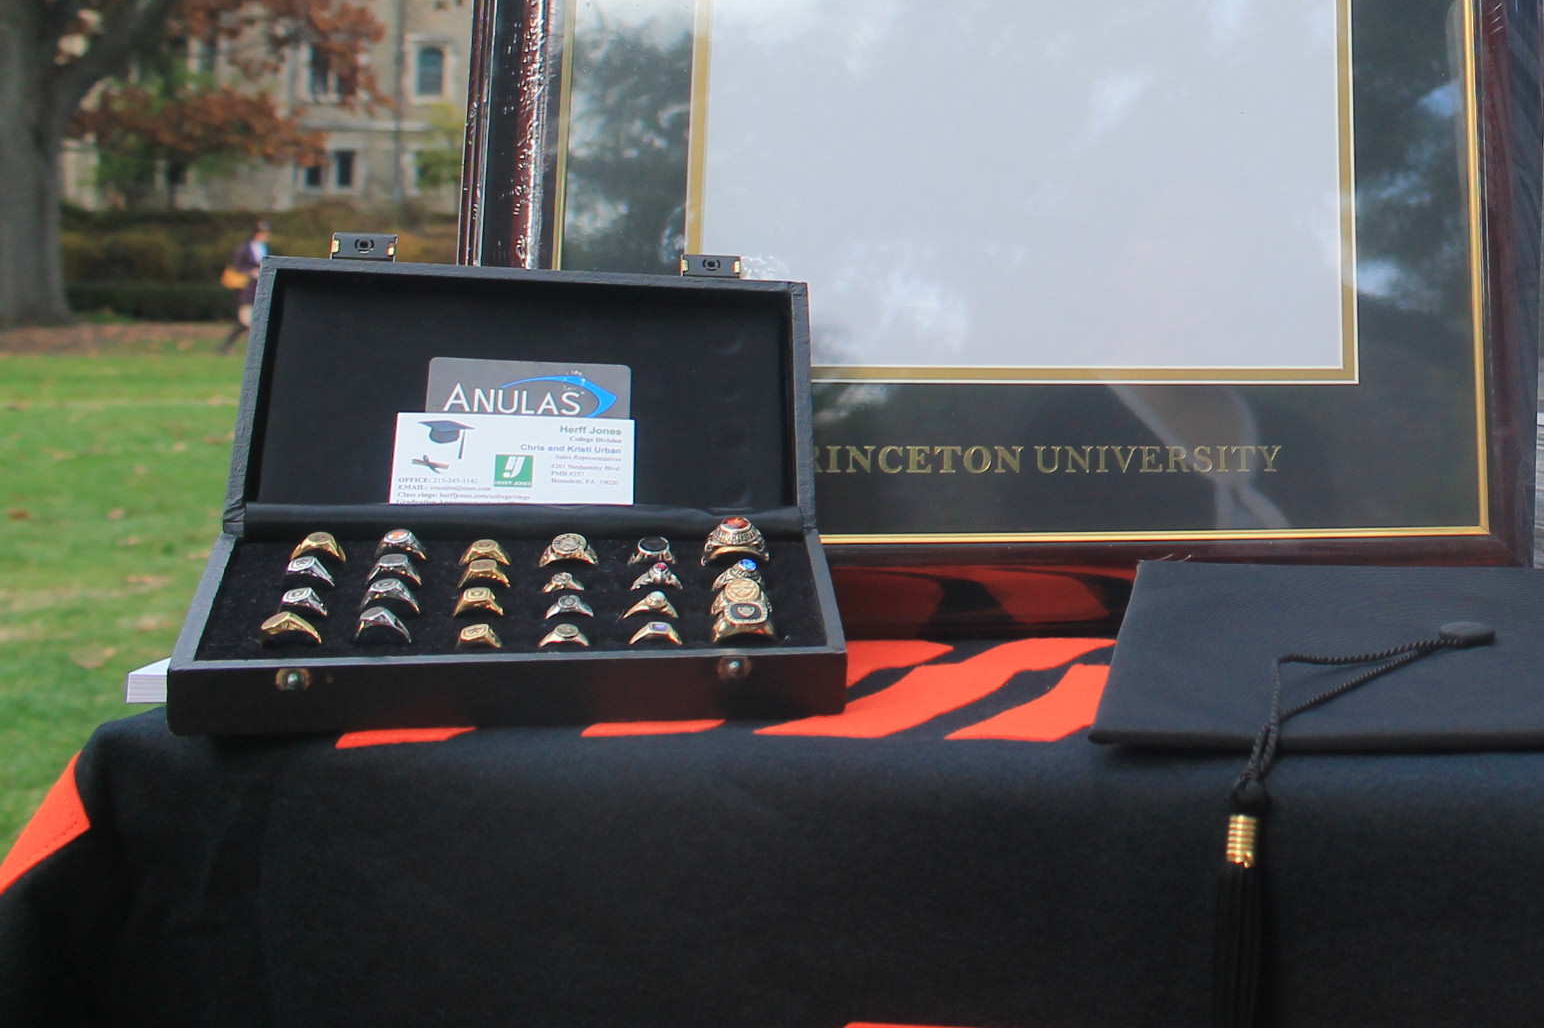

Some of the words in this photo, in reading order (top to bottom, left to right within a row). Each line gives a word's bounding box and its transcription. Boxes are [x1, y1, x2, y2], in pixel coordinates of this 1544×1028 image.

[443, 382, 581, 416] ANULAS
[560, 425, 587, 435] Herff
[589, 426, 622, 436] Jones
[520, 443, 545, 452] Chris
[547, 444, 565, 452] and
[594, 446, 622, 455] Urban
[814, 445, 1025, 474] INCETON
[1034, 445, 1283, 474] UNIVERSITY
